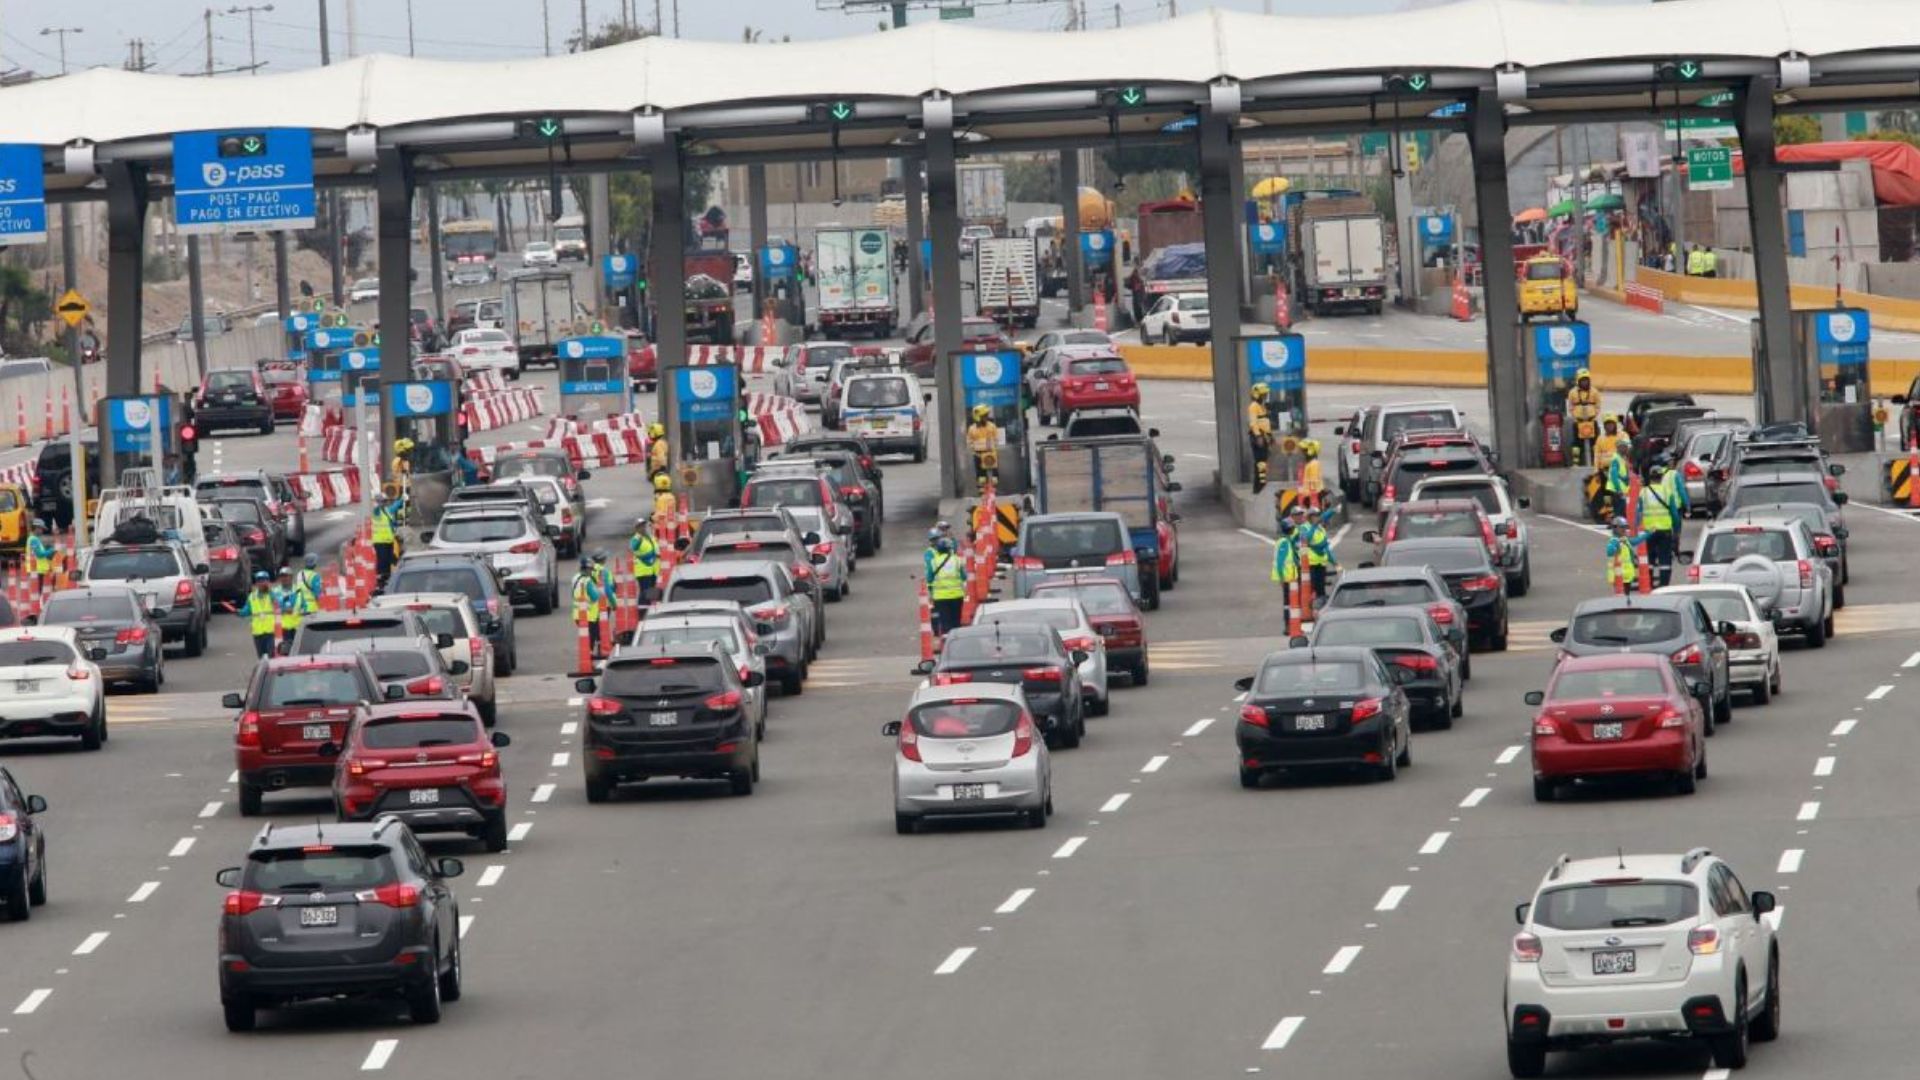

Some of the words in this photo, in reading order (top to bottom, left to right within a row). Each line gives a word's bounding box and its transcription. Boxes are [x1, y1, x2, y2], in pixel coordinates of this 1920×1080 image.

[1693, 150, 1725, 162] MOTOS
[203, 162, 286, 187] e-pass
[209, 191, 280, 206] POST-PAGO
[190, 208, 221, 221] PAGO
[227, 206, 240, 218] EN
[246, 203, 300, 217] EFECTIVO
